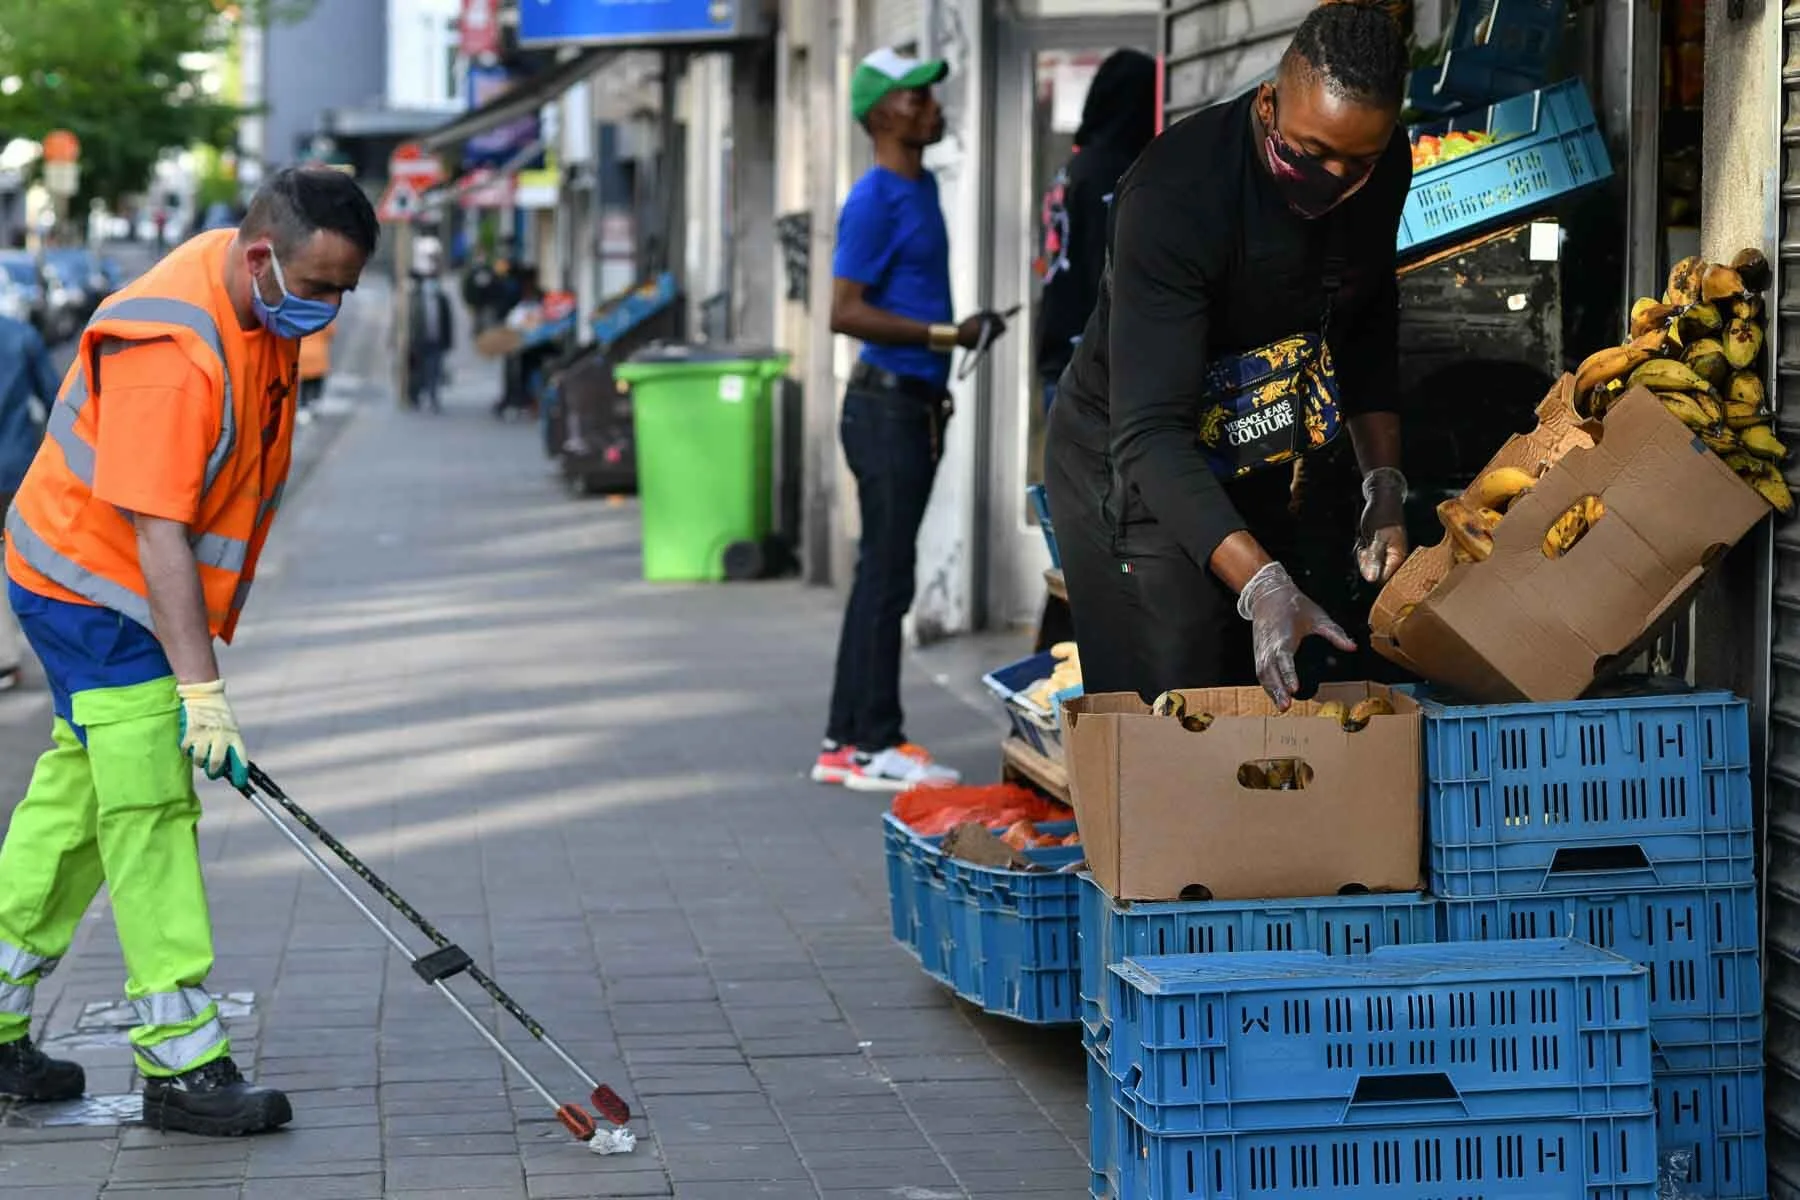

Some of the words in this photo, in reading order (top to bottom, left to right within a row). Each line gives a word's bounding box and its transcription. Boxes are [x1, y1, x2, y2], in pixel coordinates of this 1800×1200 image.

[1224, 412, 1262, 432] VERSACE
[1262, 400, 1291, 419] JEANS
[1228, 408, 1294, 446] COUTURE
